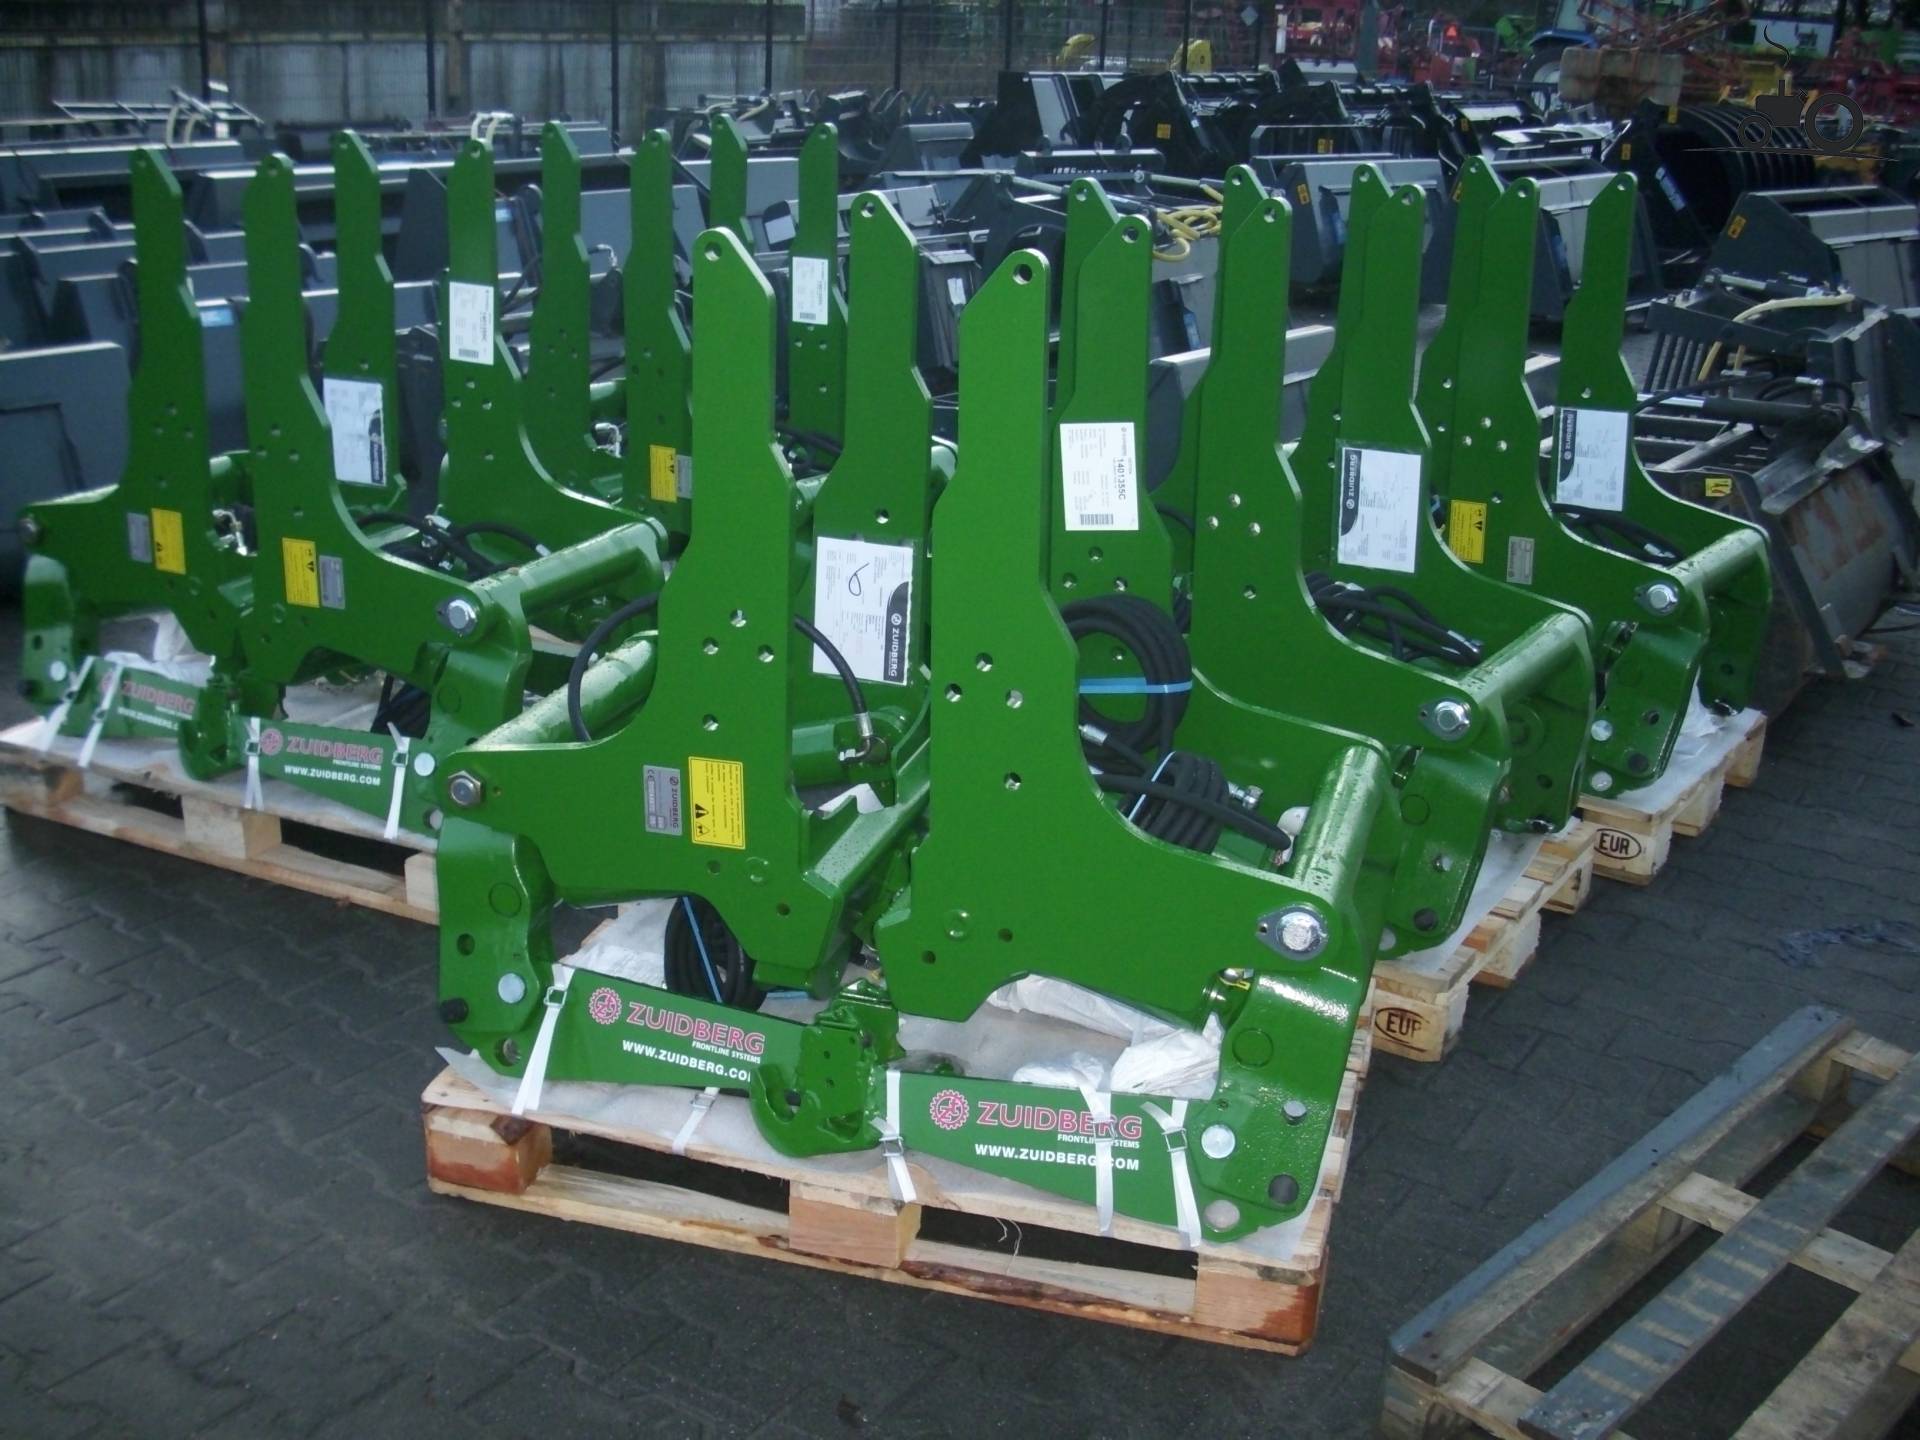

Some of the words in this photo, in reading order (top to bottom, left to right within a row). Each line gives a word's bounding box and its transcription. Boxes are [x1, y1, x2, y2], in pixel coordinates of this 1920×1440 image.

[1348, 454, 1358, 497] ZUIDBERG
[890, 627, 900, 677] ZUIDBERG
[286, 736, 383, 764] ZUIDBERG
[284, 765, 381, 786] WWW.ZUIDBERG.COM
[1599, 832, 1630, 856] EUR
[626, 1001, 766, 1055] ZUIDBERG
[622, 1039, 751, 1083] WWW.ZUIDBERG.CO
[691, 1040, 730, 1058] FRONTLINE
[731, 1050, 761, 1064] SYSTEMS
